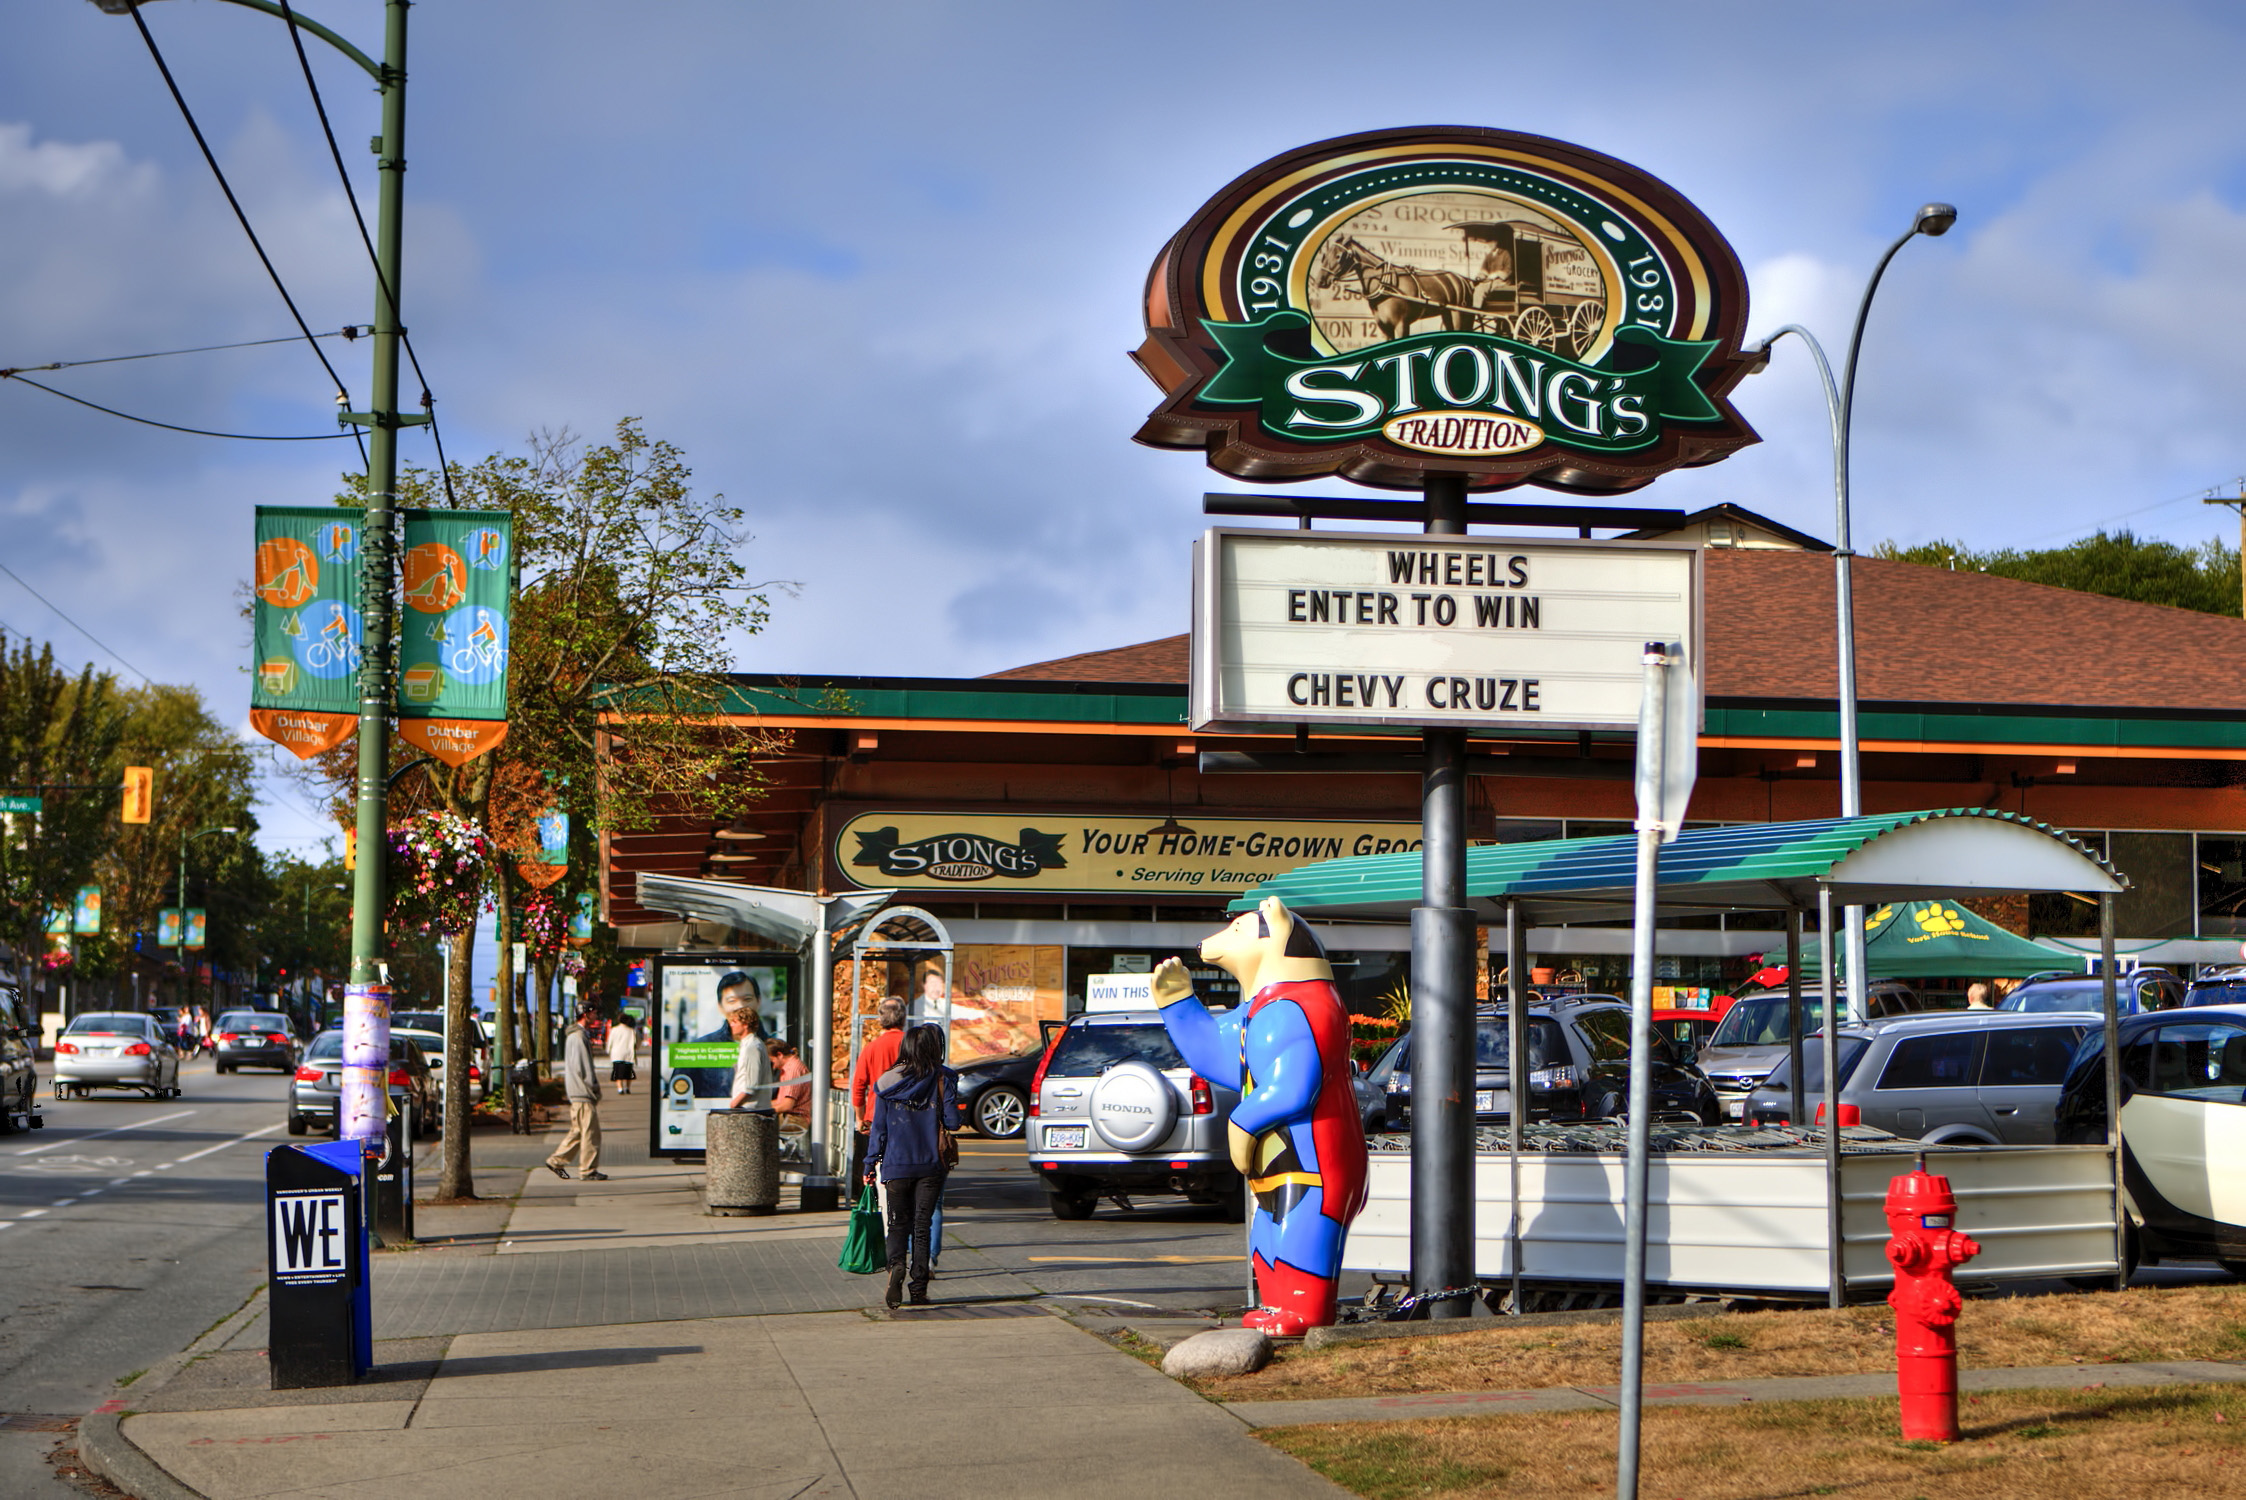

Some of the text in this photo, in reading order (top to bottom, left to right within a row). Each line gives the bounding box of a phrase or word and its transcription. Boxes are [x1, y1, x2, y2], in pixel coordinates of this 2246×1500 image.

[1380, 241, 1446, 260] Winning
[1251, 235, 1292, 313] 1931
[1566, 263, 1599, 278] GROCERY
[1628, 251, 1664, 330] 1931
[1361, 321, 1377, 338] 12
[1396, 418, 1532, 452] TRADITION
[1387, 551, 1529, 589] WHEELS
[1288, 590, 1540, 629] ENTER TO WIN
[1287, 672, 1540, 711] CHEVY CRUZE
[278, 716, 329, 733] Dunbar
[426, 725, 479, 739] Dunbar
[281, 729, 325, 746] Village
[431, 739, 475, 753] Village
[9, 800, 31, 810] Ave.
[933, 864, 990, 877] TRADITION
[1131, 867, 1205, 885] Serving
[1092, 987, 1149, 999] WIN THIS
[1101, 1103, 1153, 1115] HONDA
[280, 1198, 341, 1269] WE
